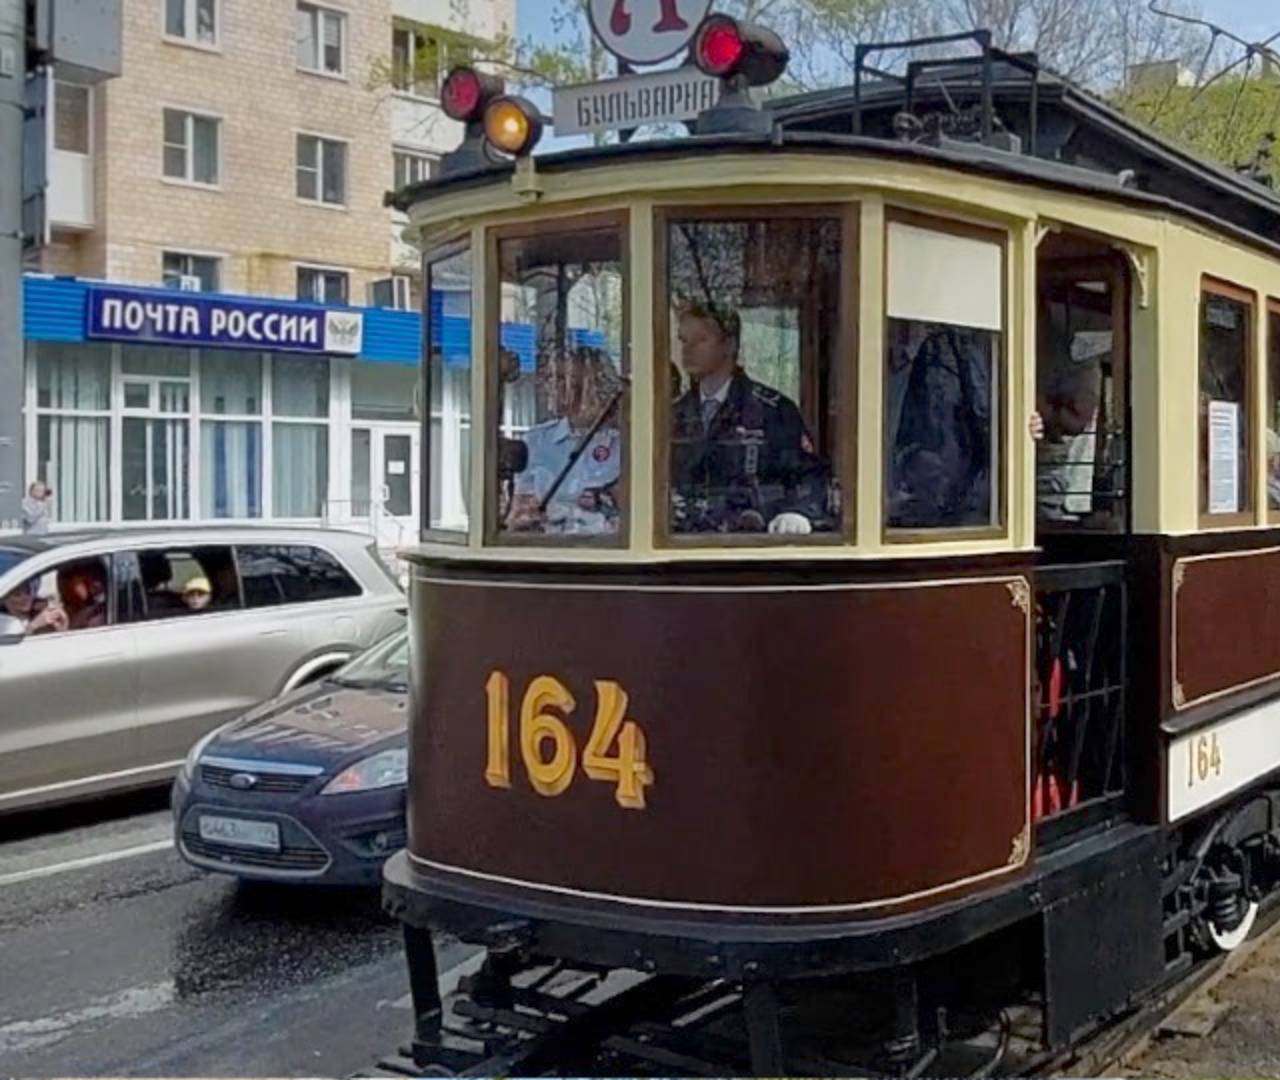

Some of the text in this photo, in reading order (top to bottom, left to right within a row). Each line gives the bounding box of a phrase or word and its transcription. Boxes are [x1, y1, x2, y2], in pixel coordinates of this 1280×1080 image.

[102, 299, 318, 343] ПОЧТА РОССИИ
[486, 671, 655, 809] 164
[1187, 732, 1221, 787] 164
